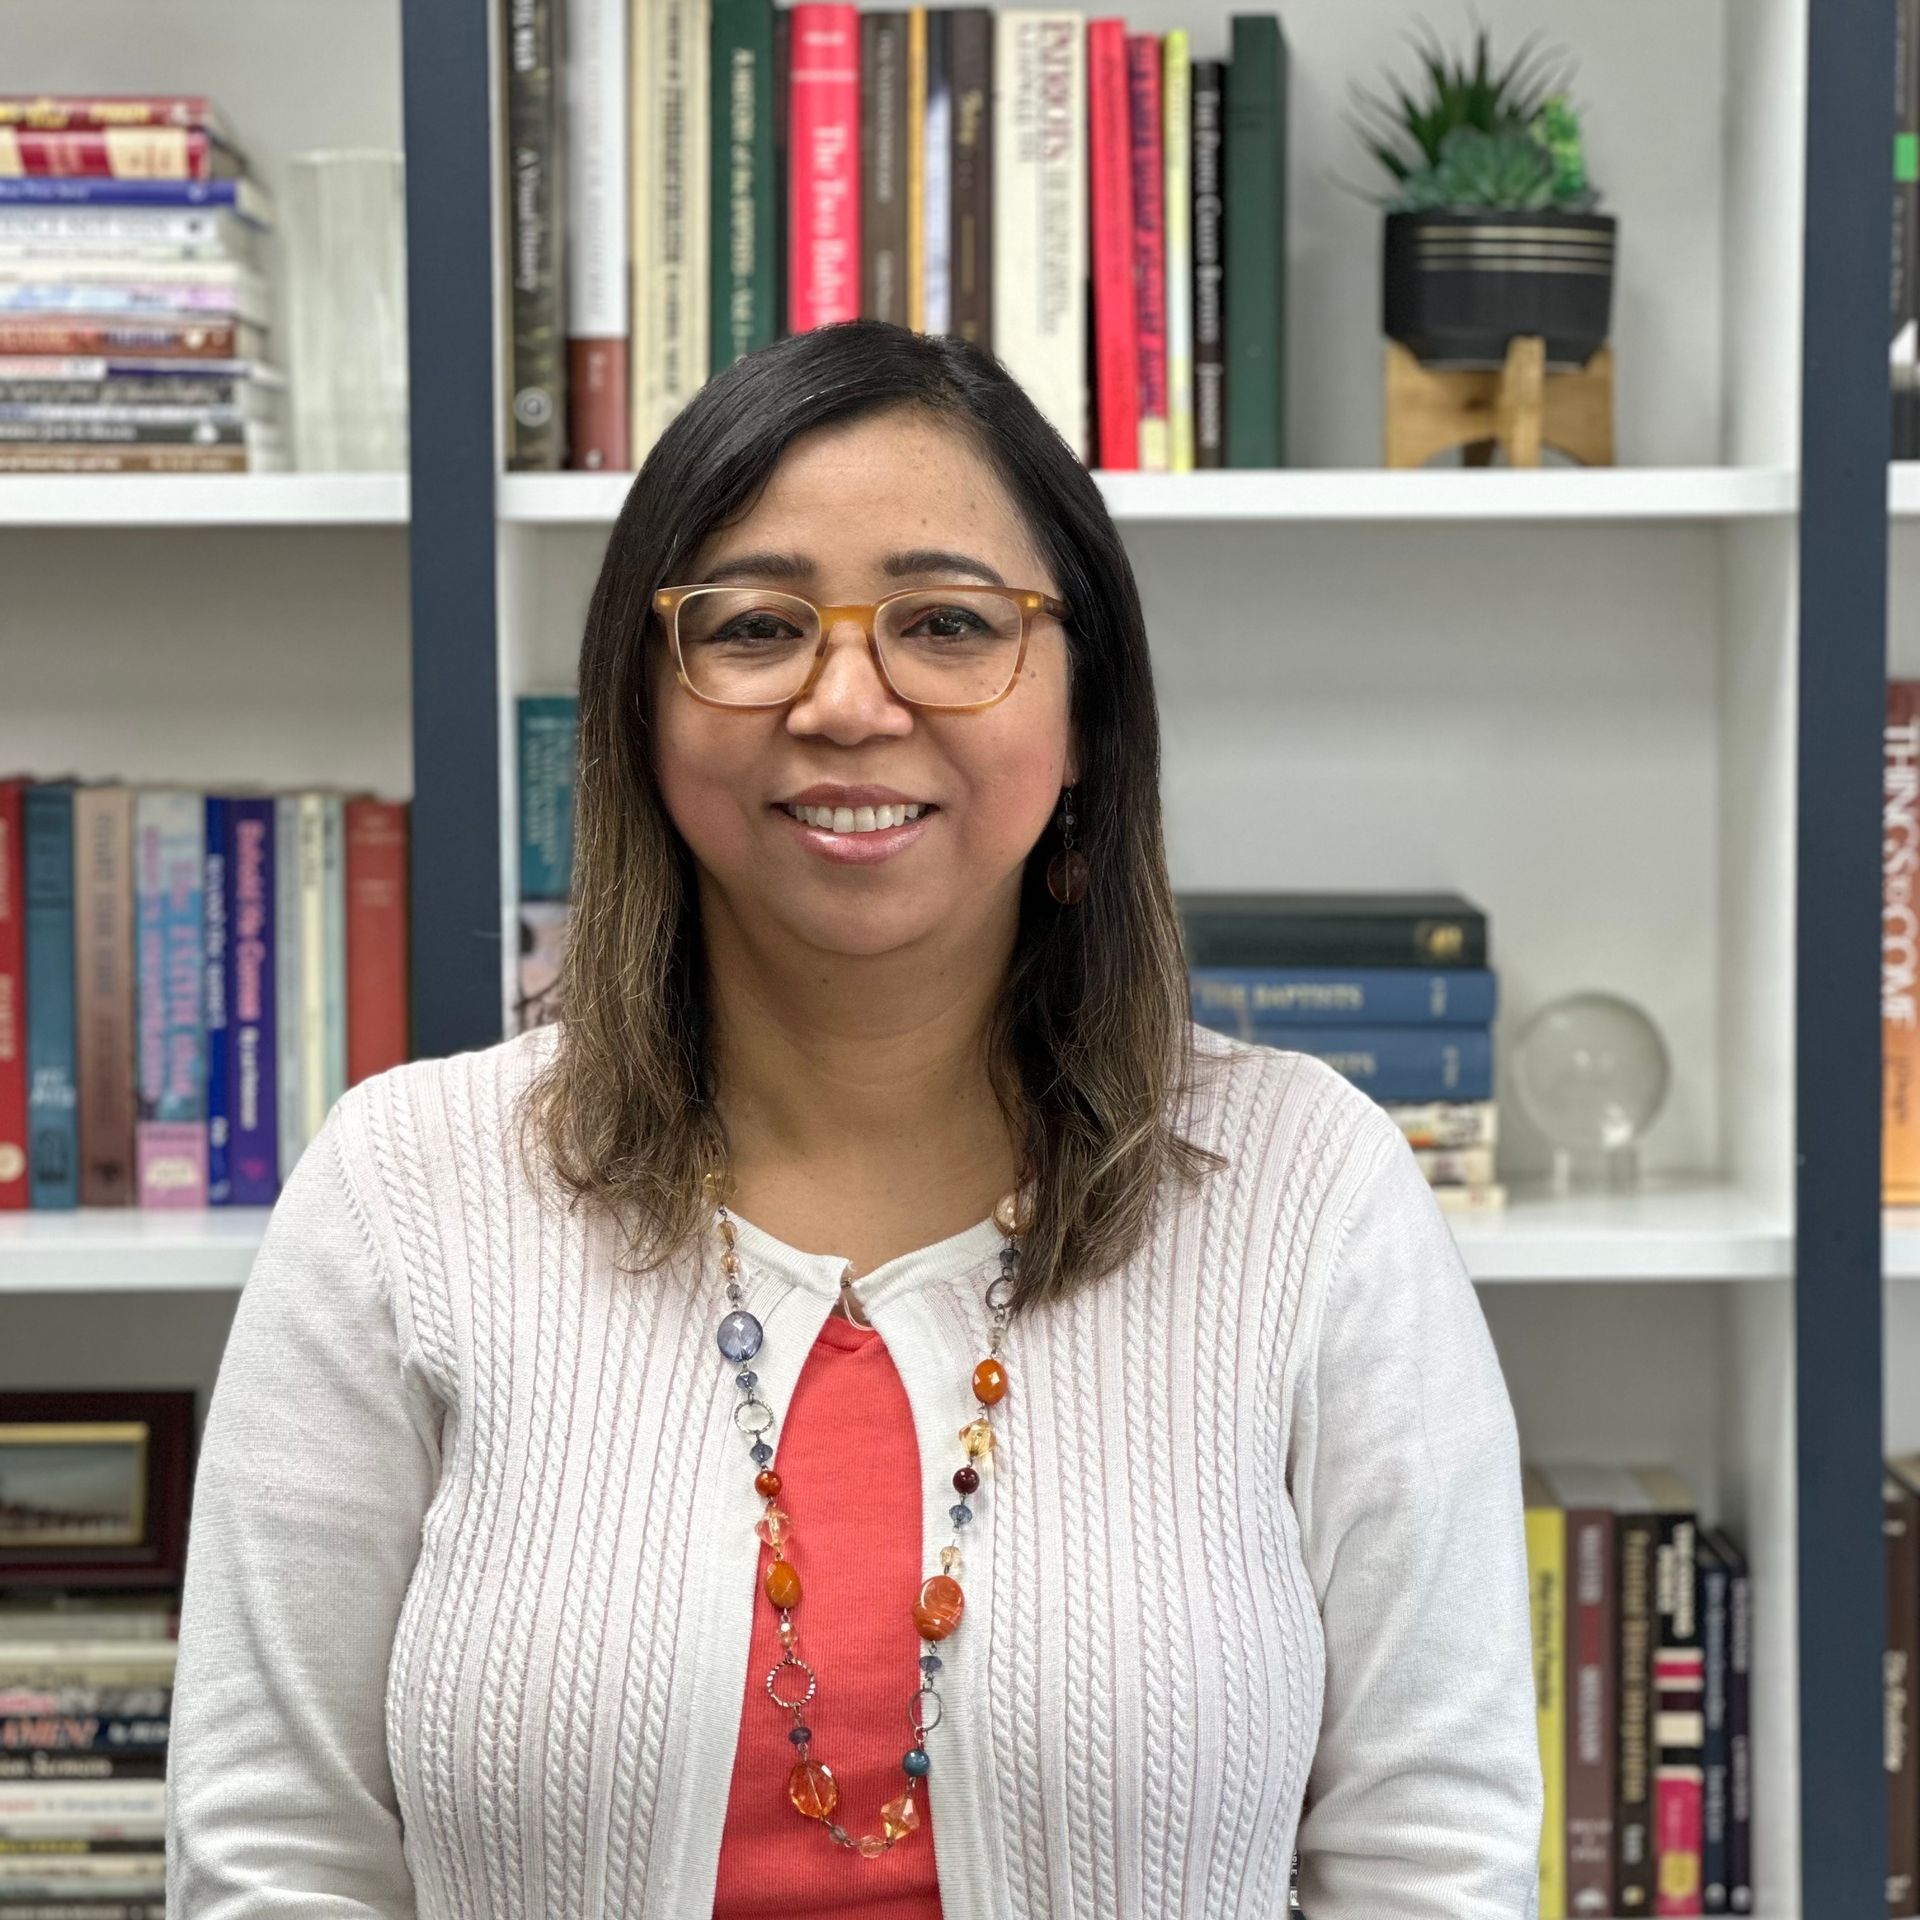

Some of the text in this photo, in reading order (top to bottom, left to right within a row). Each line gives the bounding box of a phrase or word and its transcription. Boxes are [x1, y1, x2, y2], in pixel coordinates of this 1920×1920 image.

[811, 125, 848, 174] The
[812, 179, 848, 237] Two
[1883, 722, 1919, 872] THINGS
[1882, 904, 1918, 1029] COME
